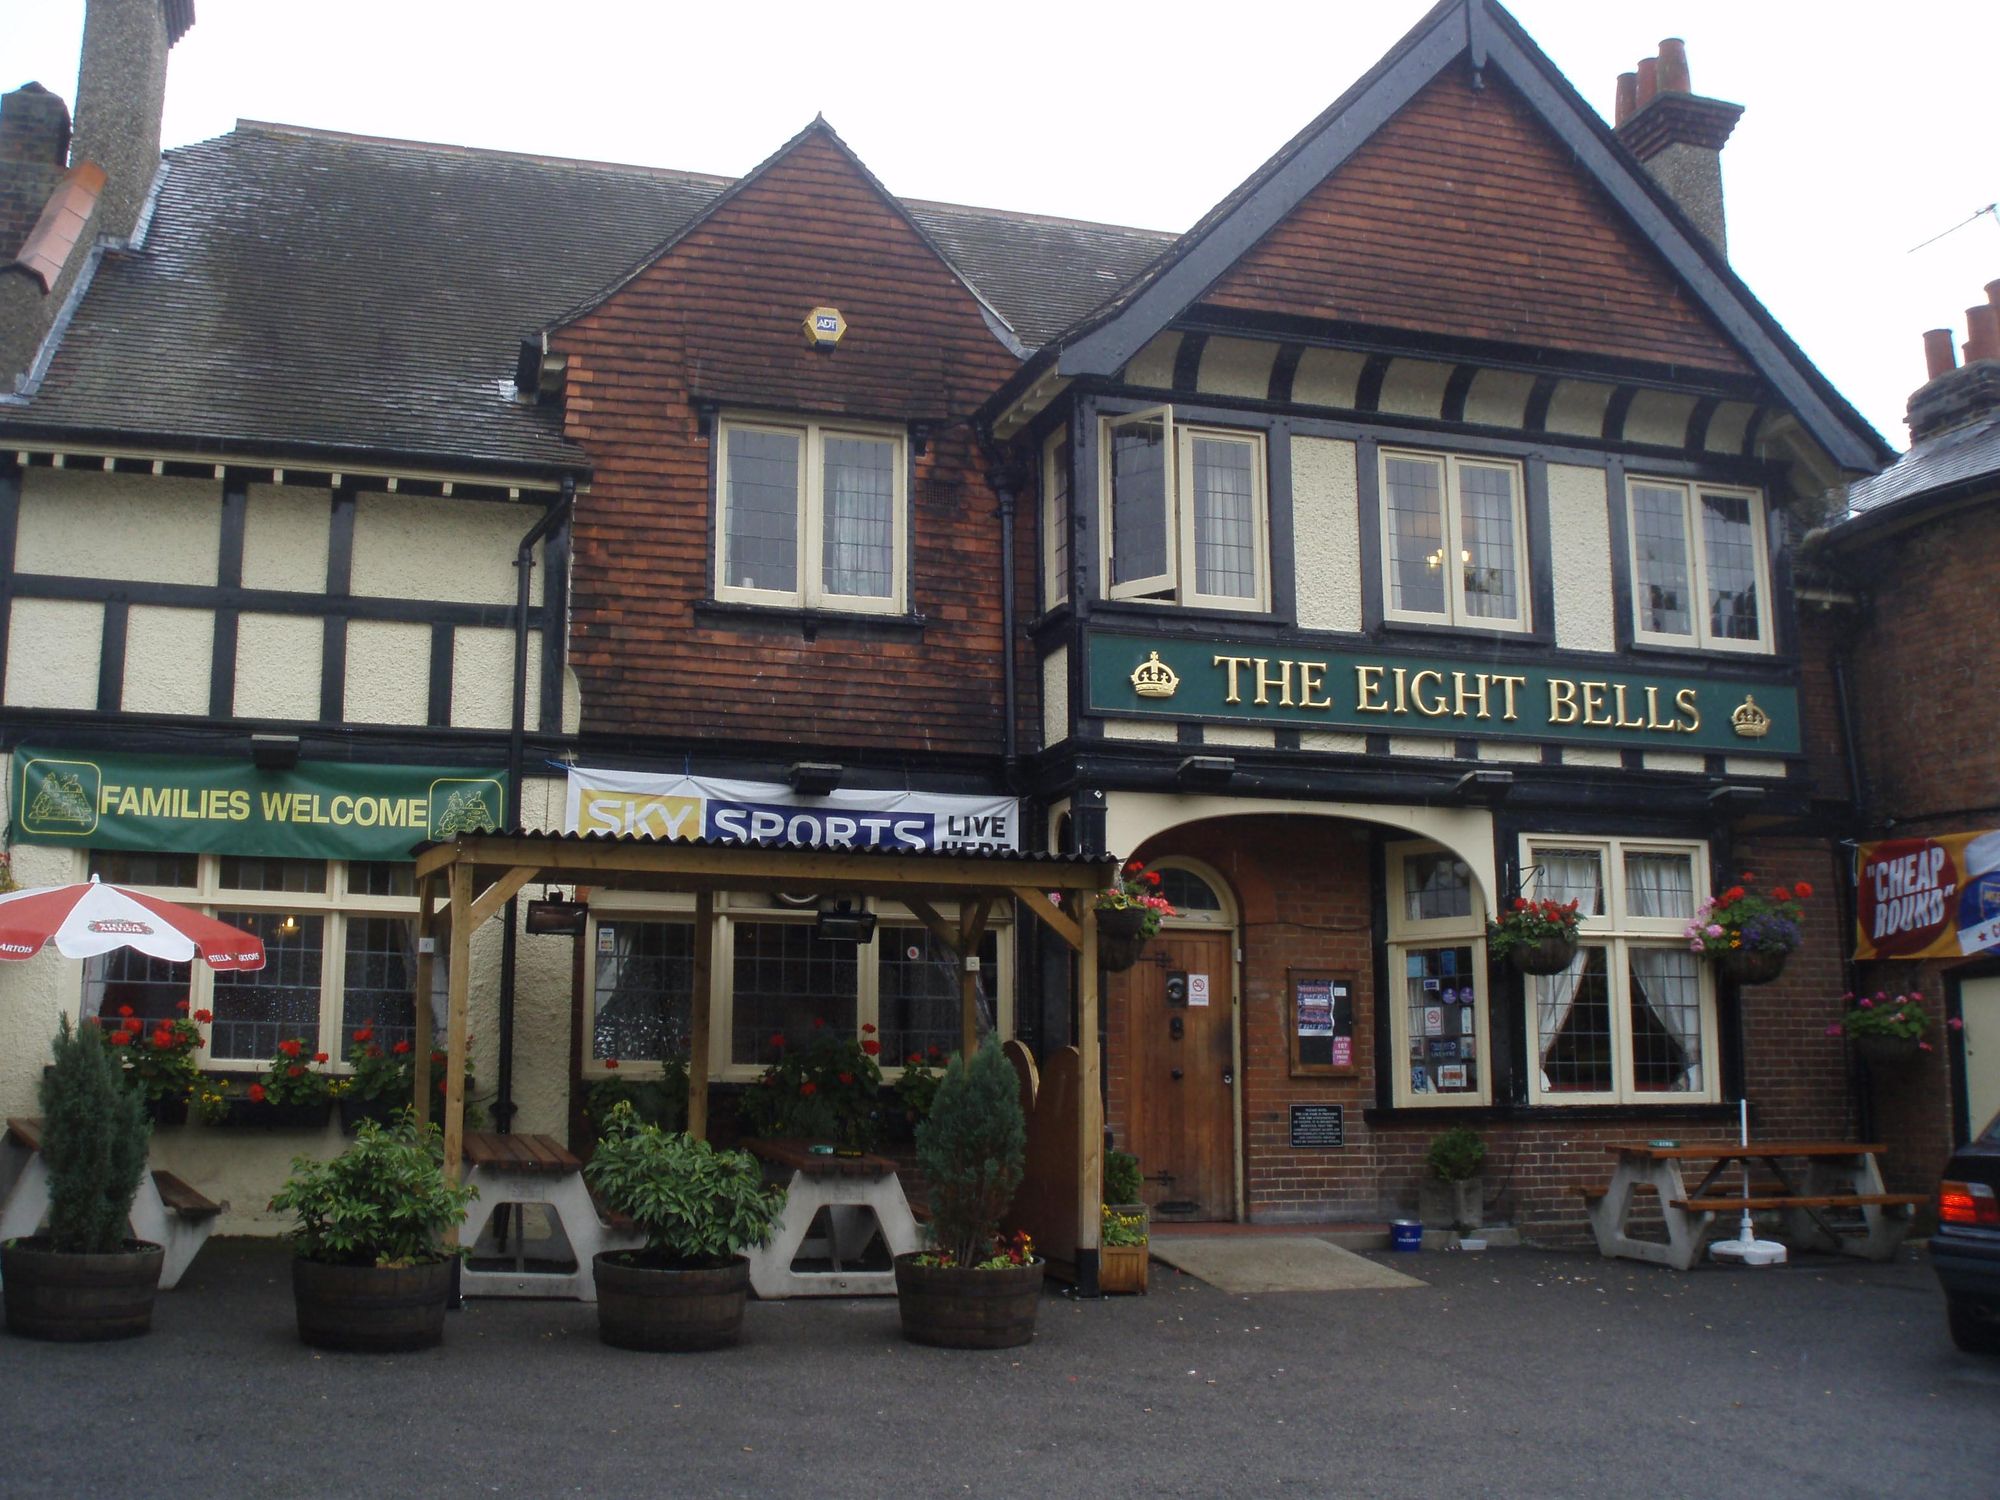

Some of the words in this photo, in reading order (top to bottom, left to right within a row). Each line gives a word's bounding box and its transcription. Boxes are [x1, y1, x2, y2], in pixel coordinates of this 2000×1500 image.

[818, 319, 836, 329] ADT
[1213, 655, 1331, 709] THE
[1356, 665, 1526, 720] EIGHT
[1547, 678, 1701, 733] BELLS
[101, 785, 251, 821] FAMILIES
[261, 791, 428, 828] WELCOME
[587, 799, 694, 839] SKY
[713, 809, 927, 851] SPORTS
[948, 815, 1006, 838] LIVE
[0, 943, 33, 953] ARTOIS
[208, 954, 232, 962] STELLA
[238, 952, 260, 961] RTOIS
